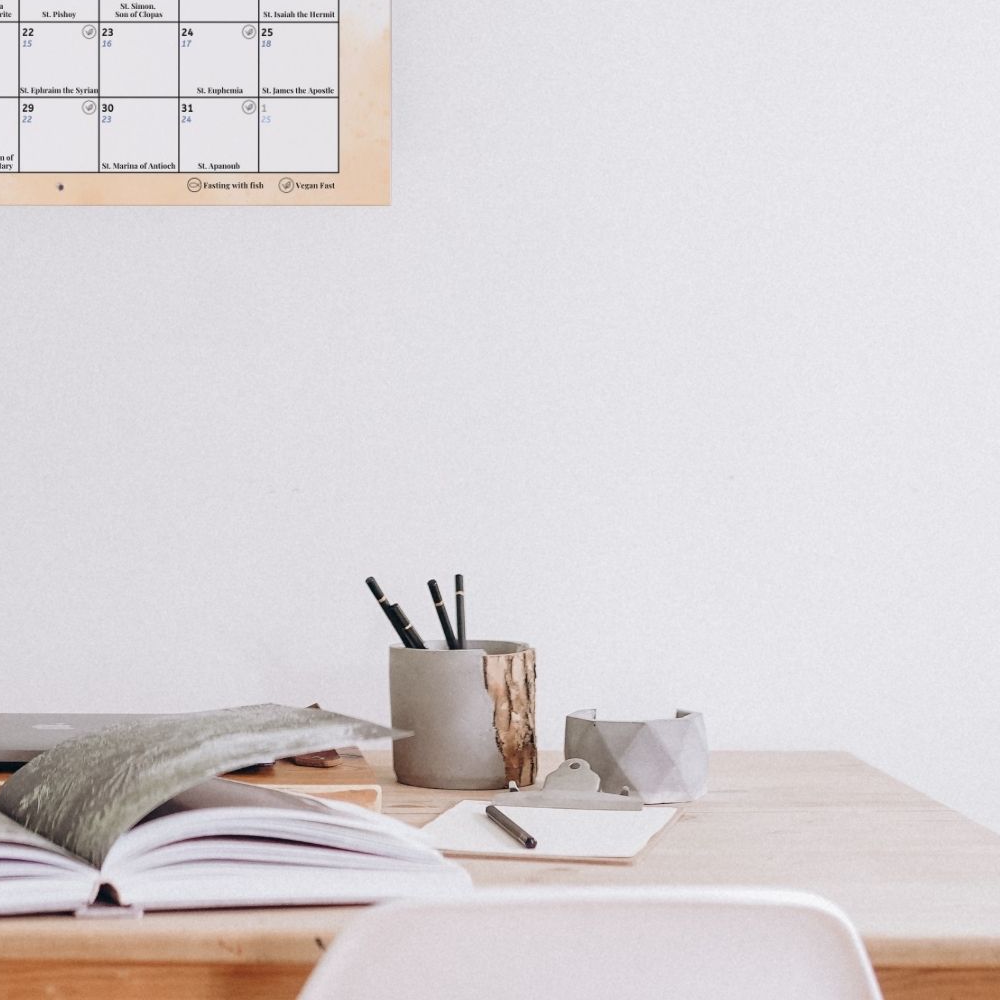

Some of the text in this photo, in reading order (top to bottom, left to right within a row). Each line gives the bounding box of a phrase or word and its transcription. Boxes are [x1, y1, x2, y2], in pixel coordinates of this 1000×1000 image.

[261, 28, 274, 37] 25
[272, 87, 294, 95] James
[309, 86, 335, 96] Apostle
[101, 103, 114, 113] 30
[181, 103, 194, 113] 31
[148, 162, 176, 170] Antioch
[203, 181, 264, 190] Fasting with fish
[295, 182, 318, 190] Vegan
